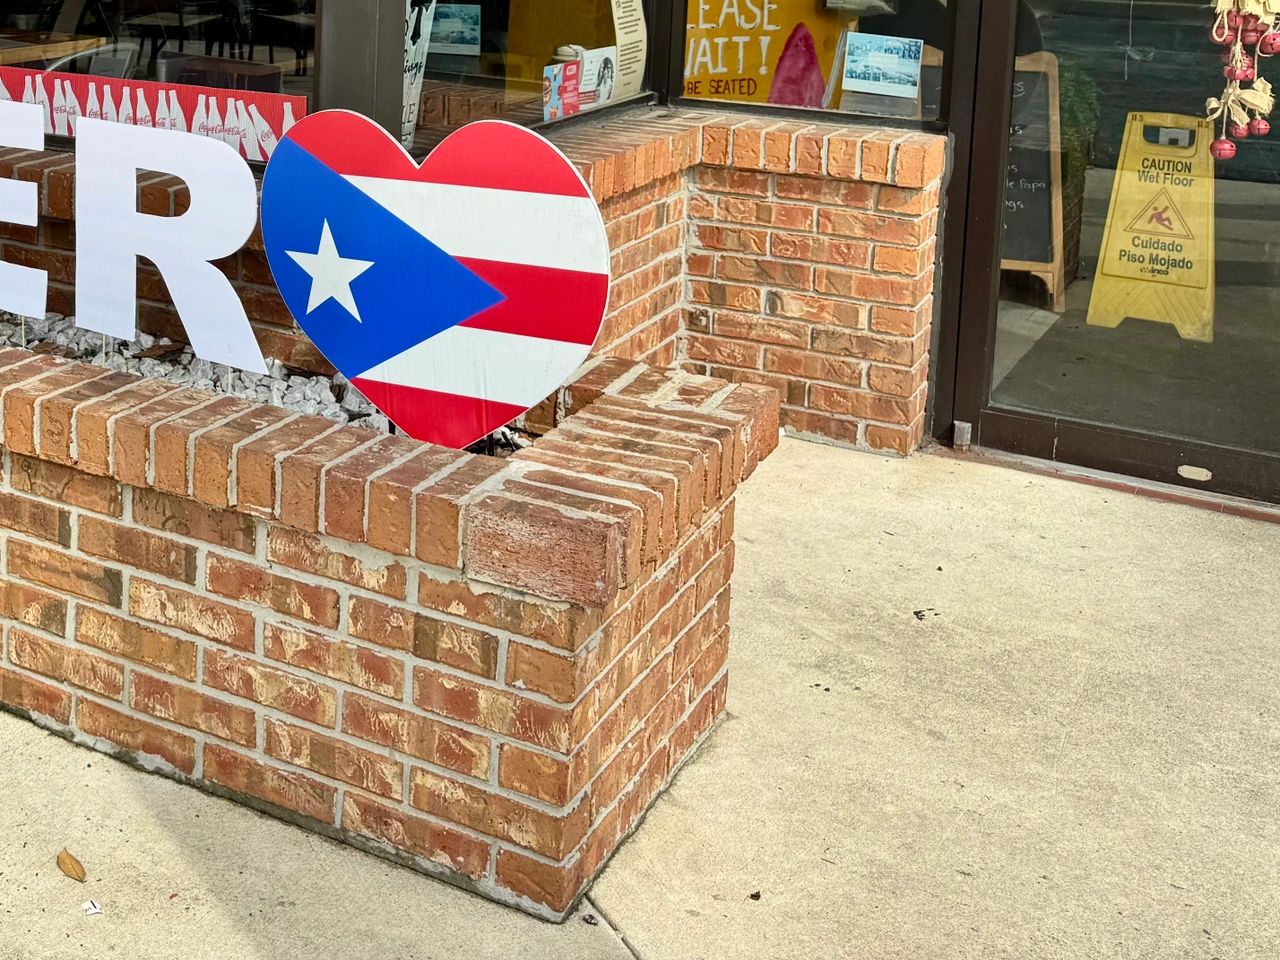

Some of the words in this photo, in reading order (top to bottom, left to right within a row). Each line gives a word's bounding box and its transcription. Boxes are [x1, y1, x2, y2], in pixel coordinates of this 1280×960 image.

[687, 81, 702, 95] BE
[709, 78, 757, 96] SEATED
[1142, 157, 1192, 173] CAUTION
[1138, 170, 1160, 184] Wet
[1163, 174, 1195, 187] Floor
[1132, 236, 1183, 253] Cuidado
[1119, 249, 1145, 264] Piso
[1149, 253, 1193, 270] Mojado
